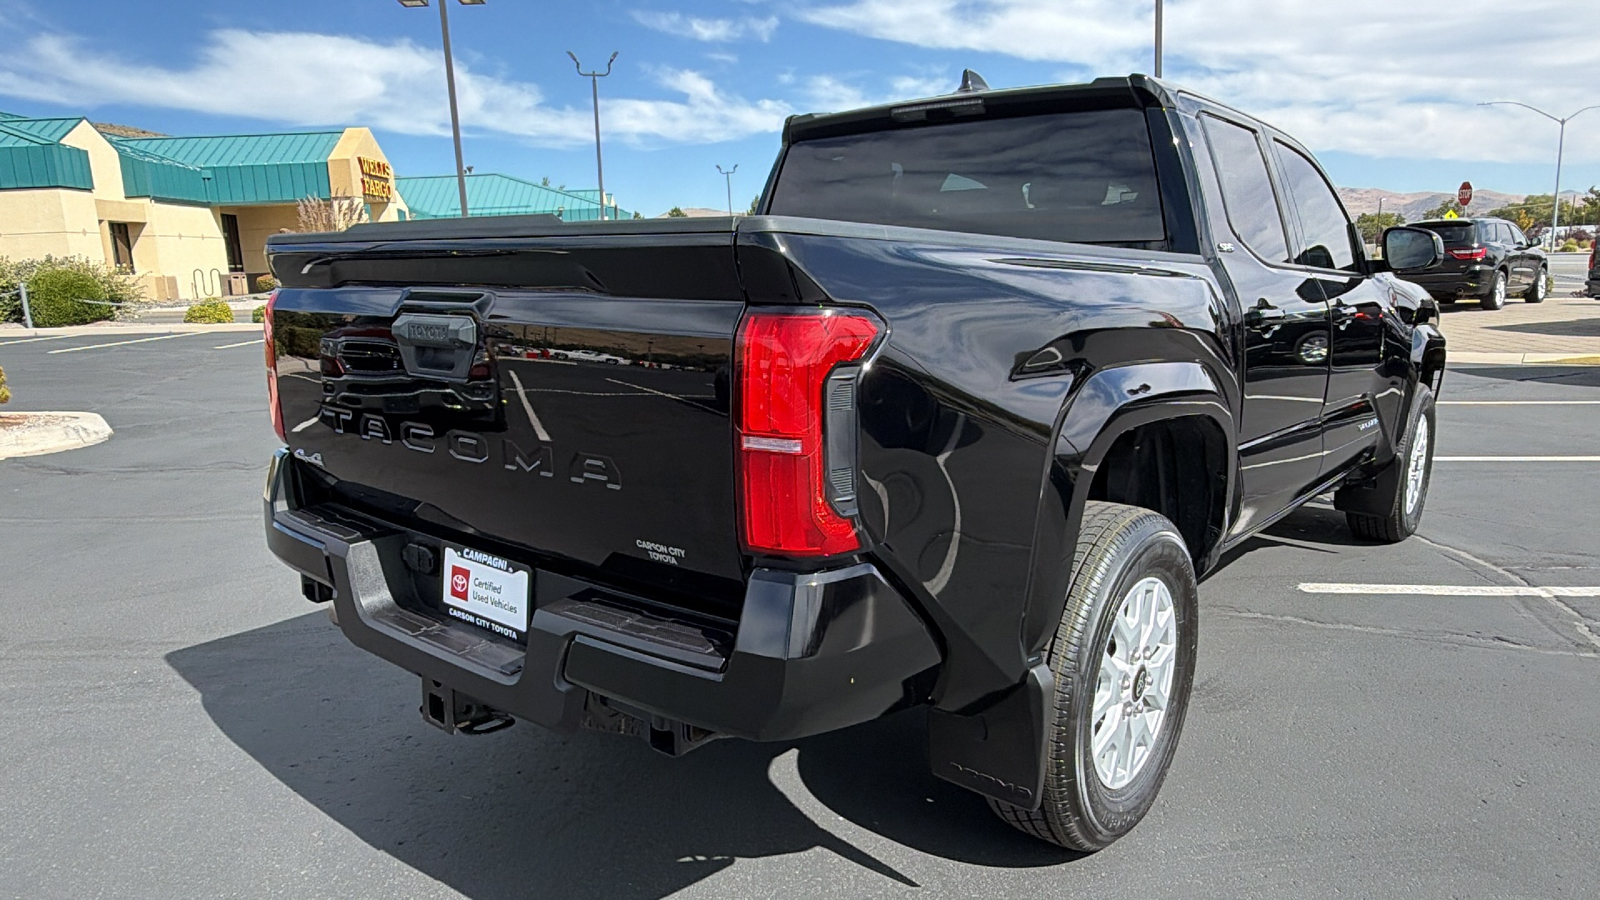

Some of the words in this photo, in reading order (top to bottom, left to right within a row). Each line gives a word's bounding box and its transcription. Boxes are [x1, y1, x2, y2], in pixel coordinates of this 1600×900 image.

[357, 157, 391, 178] WELLS
[361, 178, 393, 198] FARGO
[1459, 189, 1472, 198] STOP
[408, 325, 448, 339] TOYOTA
[320, 408, 622, 490] TACOMA
[636, 539, 668, 553] CARSON
[668, 547, 685, 558] CITY
[648, 551, 678, 565] TOYOTA
[463, 548, 508, 571] CAMPAGNI
[473, 577, 502, 595] Certified
[472, 590, 489, 604] Used
[490, 596, 518, 614] Vehicles
[448, 608, 475, 623] CARSON
[476, 618, 490, 629] CITY
[491, 623, 518, 640] TOYOTA
